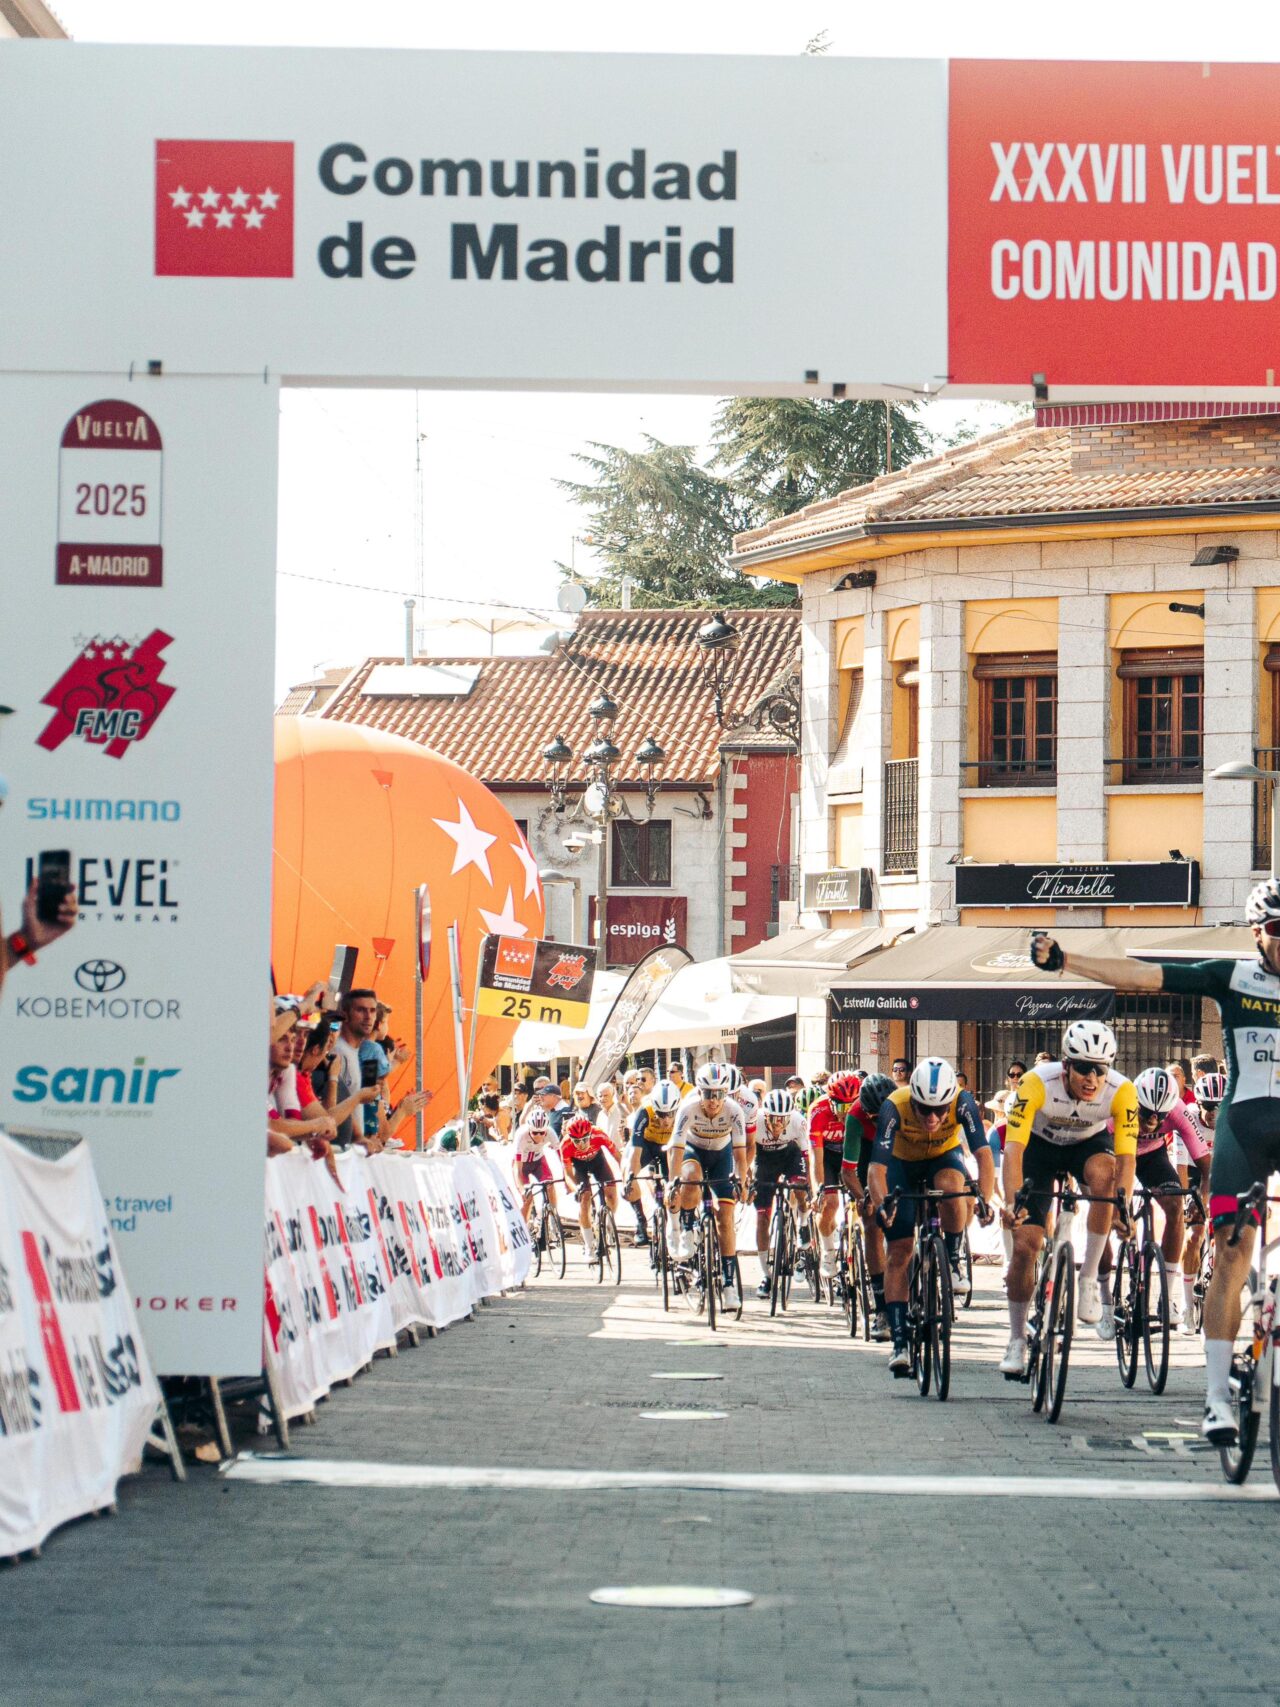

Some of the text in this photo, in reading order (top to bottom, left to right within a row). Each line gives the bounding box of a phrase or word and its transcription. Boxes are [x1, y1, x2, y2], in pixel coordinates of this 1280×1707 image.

[318, 141, 737, 201] Comunidad
[990, 142, 1146, 203] XXXVII
[318, 221, 735, 283] de Madrid
[990, 239, 1277, 301] COMUNIDAD
[76, 415, 149, 441] VUELTA
[76, 483, 147, 516] 2025
[69, 555, 149, 577] A-MADRID
[75, 709, 143, 739] FMC
[27, 798, 181, 822] SHIMANO
[26, 857, 178, 907] EVEL
[1026, 868, 1116, 903] Mirabella
[79, 913, 178, 922] RTWEAR
[610, 922, 661, 938] espiga
[492, 980, 531, 992] de Madrid
[493, 974, 532, 986] Comunidad
[16, 996, 182, 1019] KOBEMOTOR
[501, 996, 562, 1024] 25 m
[843, 996, 908, 1009] Estrella Galicia
[1015, 995, 1054, 1016] Pizzeria
[12, 1056, 182, 1104] sanir
[115, 1193, 173, 1212] travel
